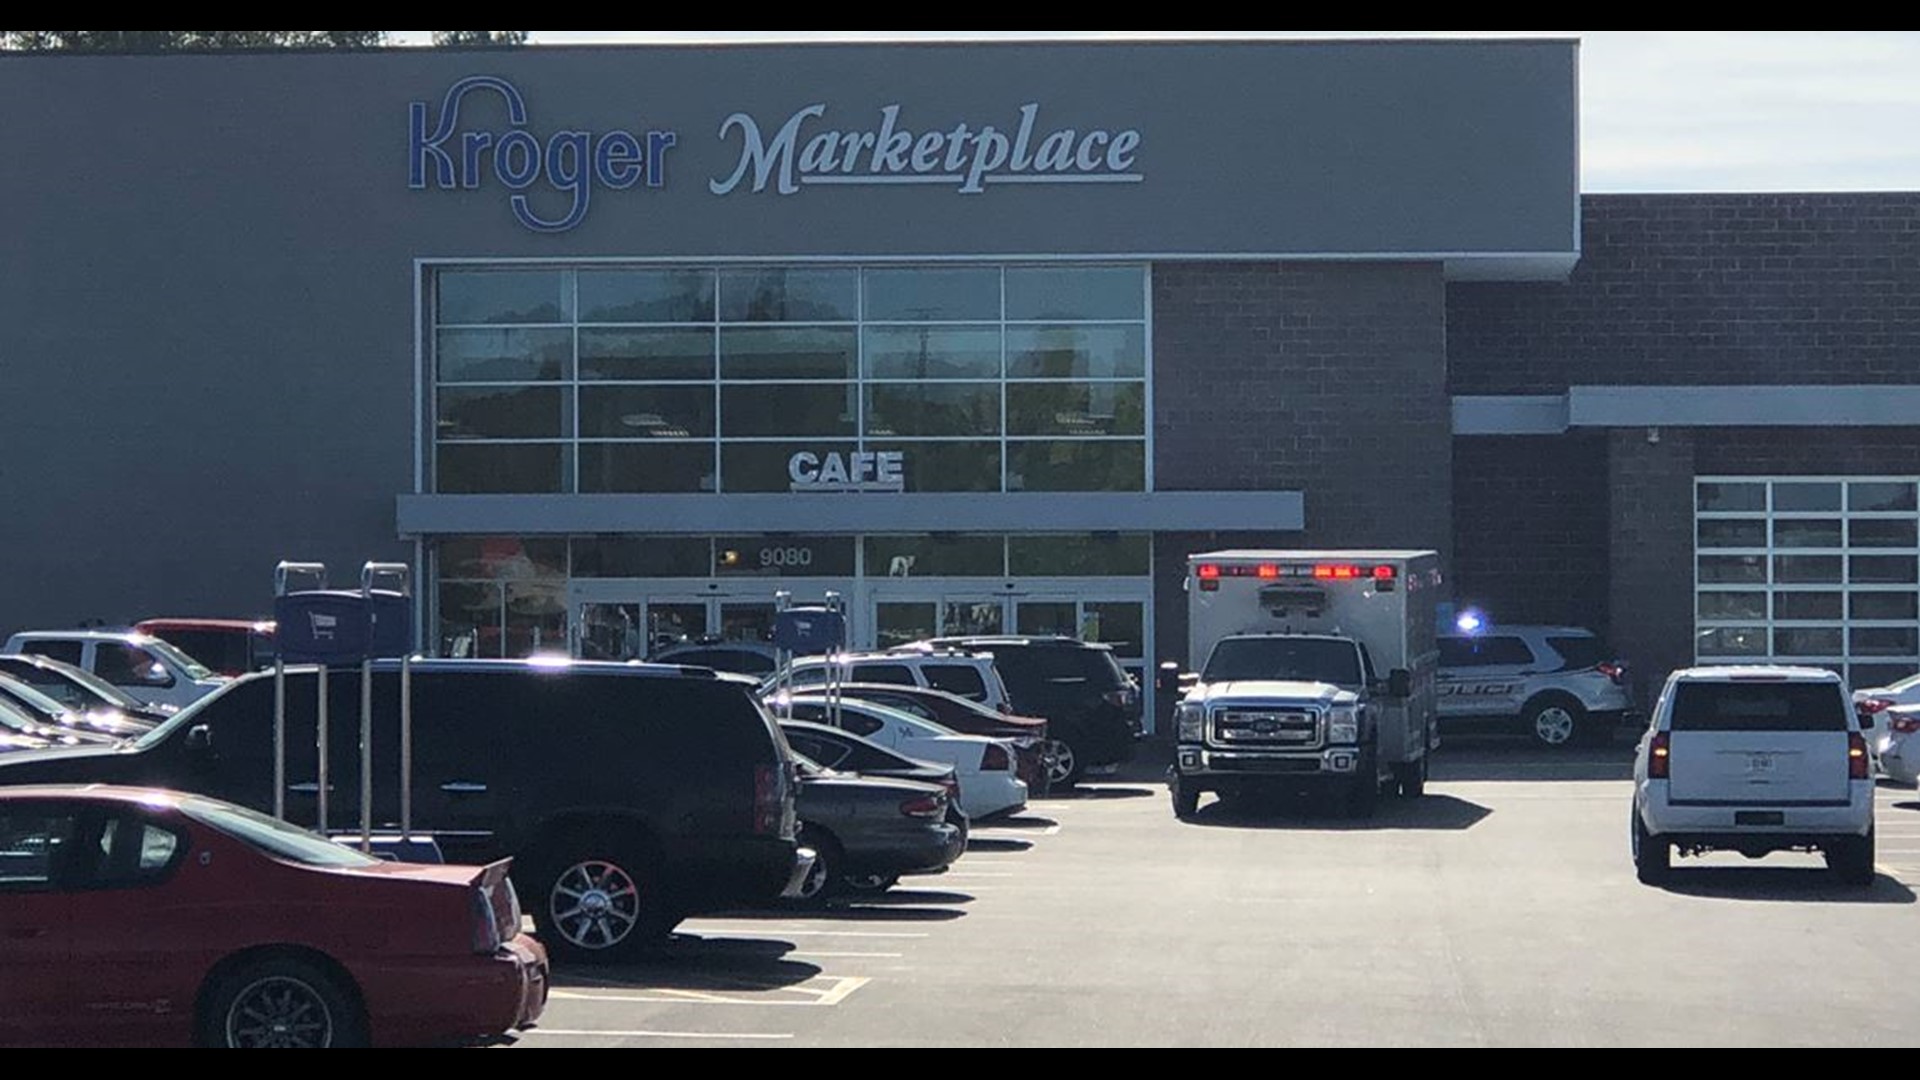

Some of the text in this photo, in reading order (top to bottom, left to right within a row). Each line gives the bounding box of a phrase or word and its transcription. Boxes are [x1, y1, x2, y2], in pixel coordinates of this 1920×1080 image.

[408, 76, 1143, 233] Kroger Marketplace
[788, 451, 904, 483] CAFE
[759, 548, 812, 566] 9080
